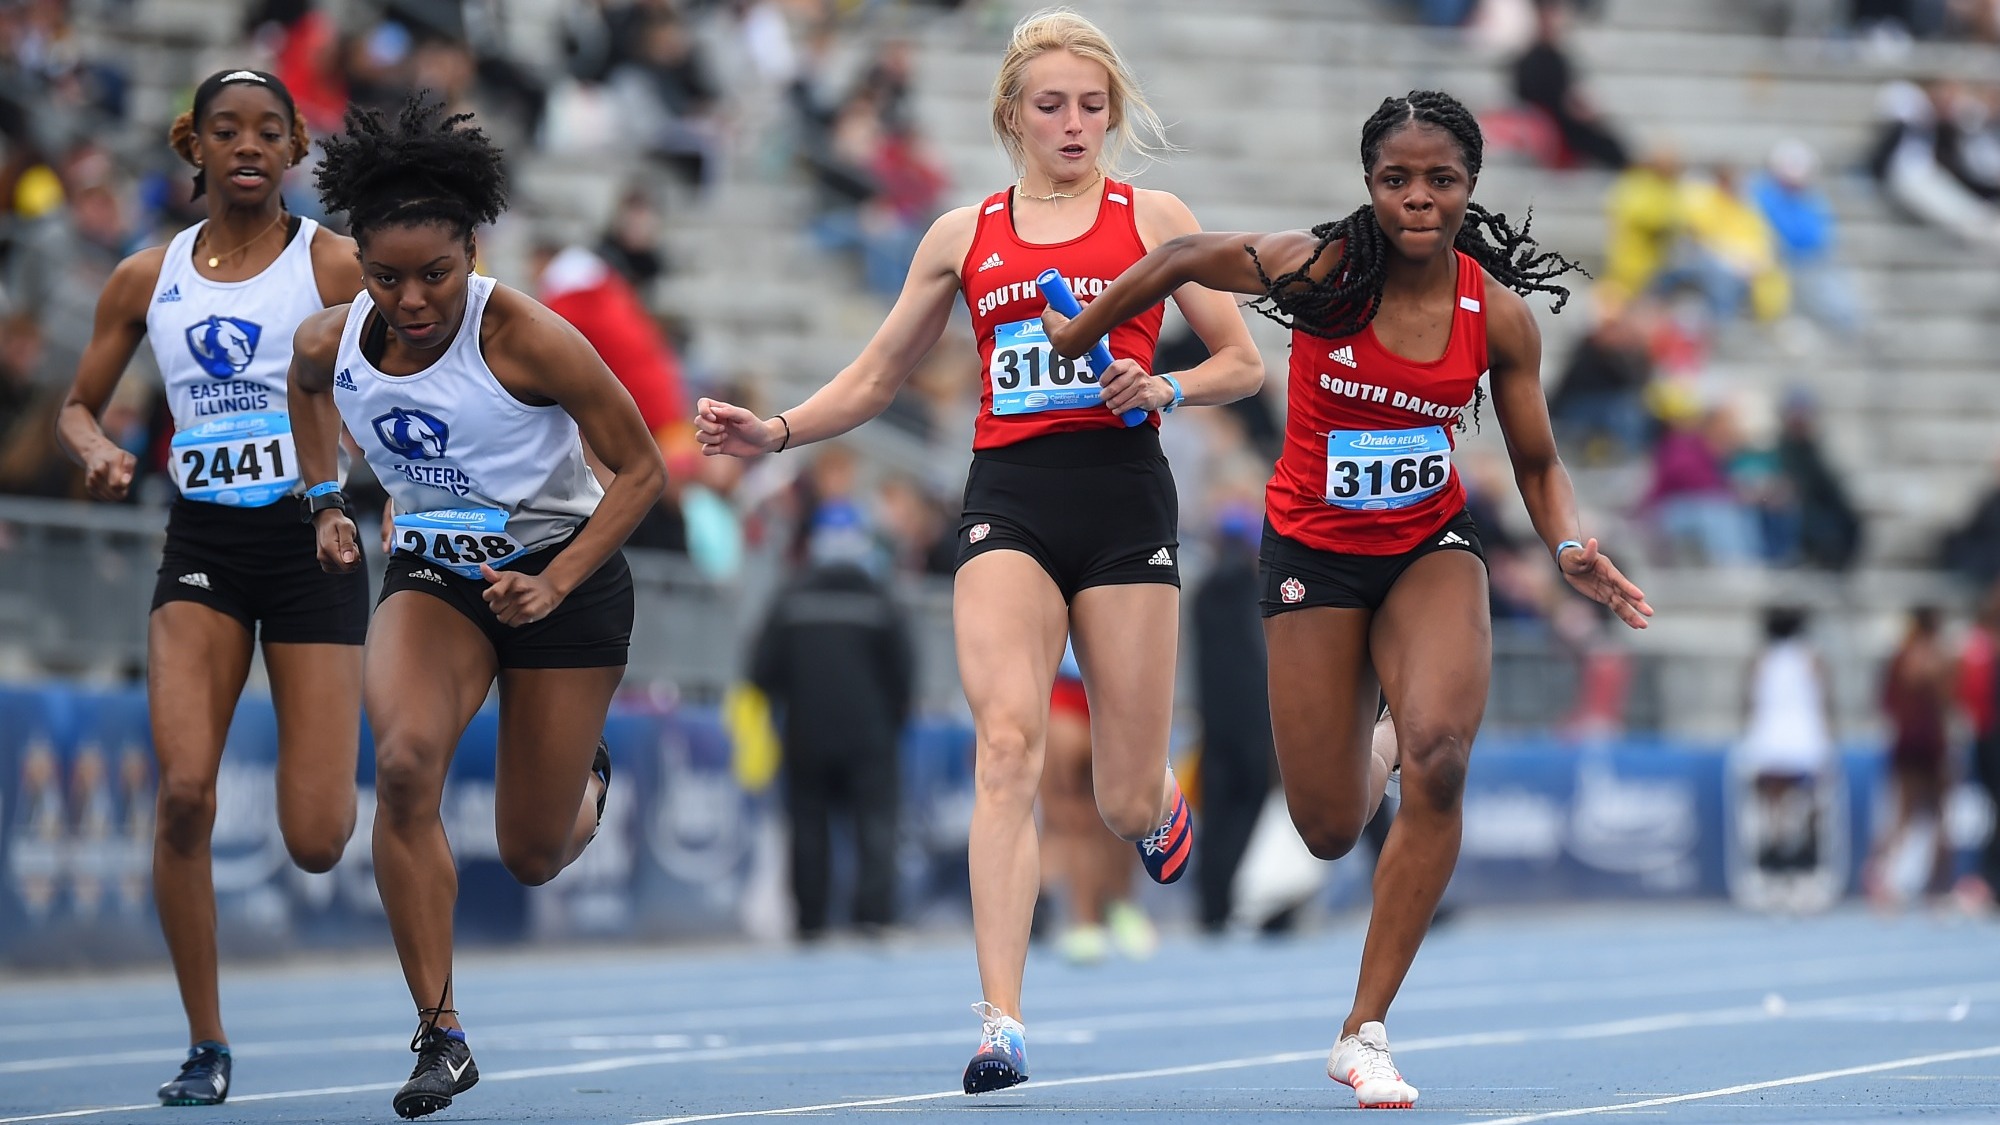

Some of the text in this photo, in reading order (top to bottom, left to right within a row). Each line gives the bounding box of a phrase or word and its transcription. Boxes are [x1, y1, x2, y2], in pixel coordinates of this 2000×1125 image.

[977, 277, 1113, 317] SOUTH AKO
[1328, 351, 1358, 369] adidas
[190, 379, 271, 400] EASTERN
[335, 380, 358, 392] adidas
[1319, 373, 1464, 419] SOUTH DAKOT
[194, 394, 268, 417] ILLINOIS
[1358, 432, 1426, 446] Drake RELAYS
[181, 439, 285, 489] 2441
[1333, 454, 1445, 498] 3166
[457, 511, 486, 520] RELAYS
[403, 530, 516, 564] 2438
